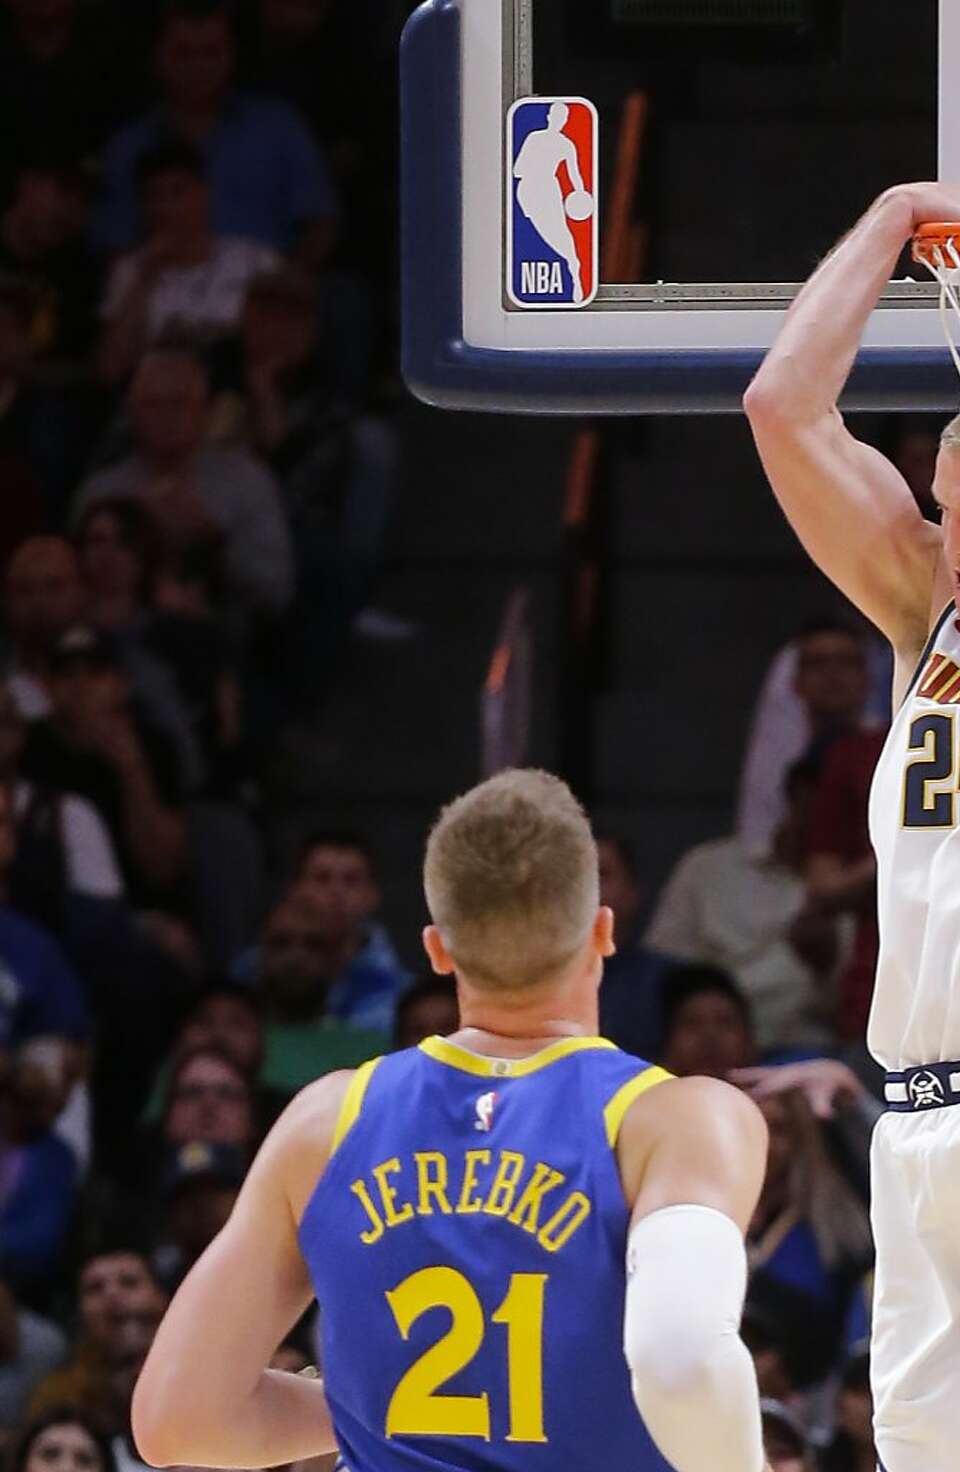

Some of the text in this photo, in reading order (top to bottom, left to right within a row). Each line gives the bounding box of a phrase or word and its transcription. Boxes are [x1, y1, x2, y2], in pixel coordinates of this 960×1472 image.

[520, 261, 564, 294] NBA
[350, 1148, 592, 1252] JEREBKO
[384, 1264, 549, 1443] 21
